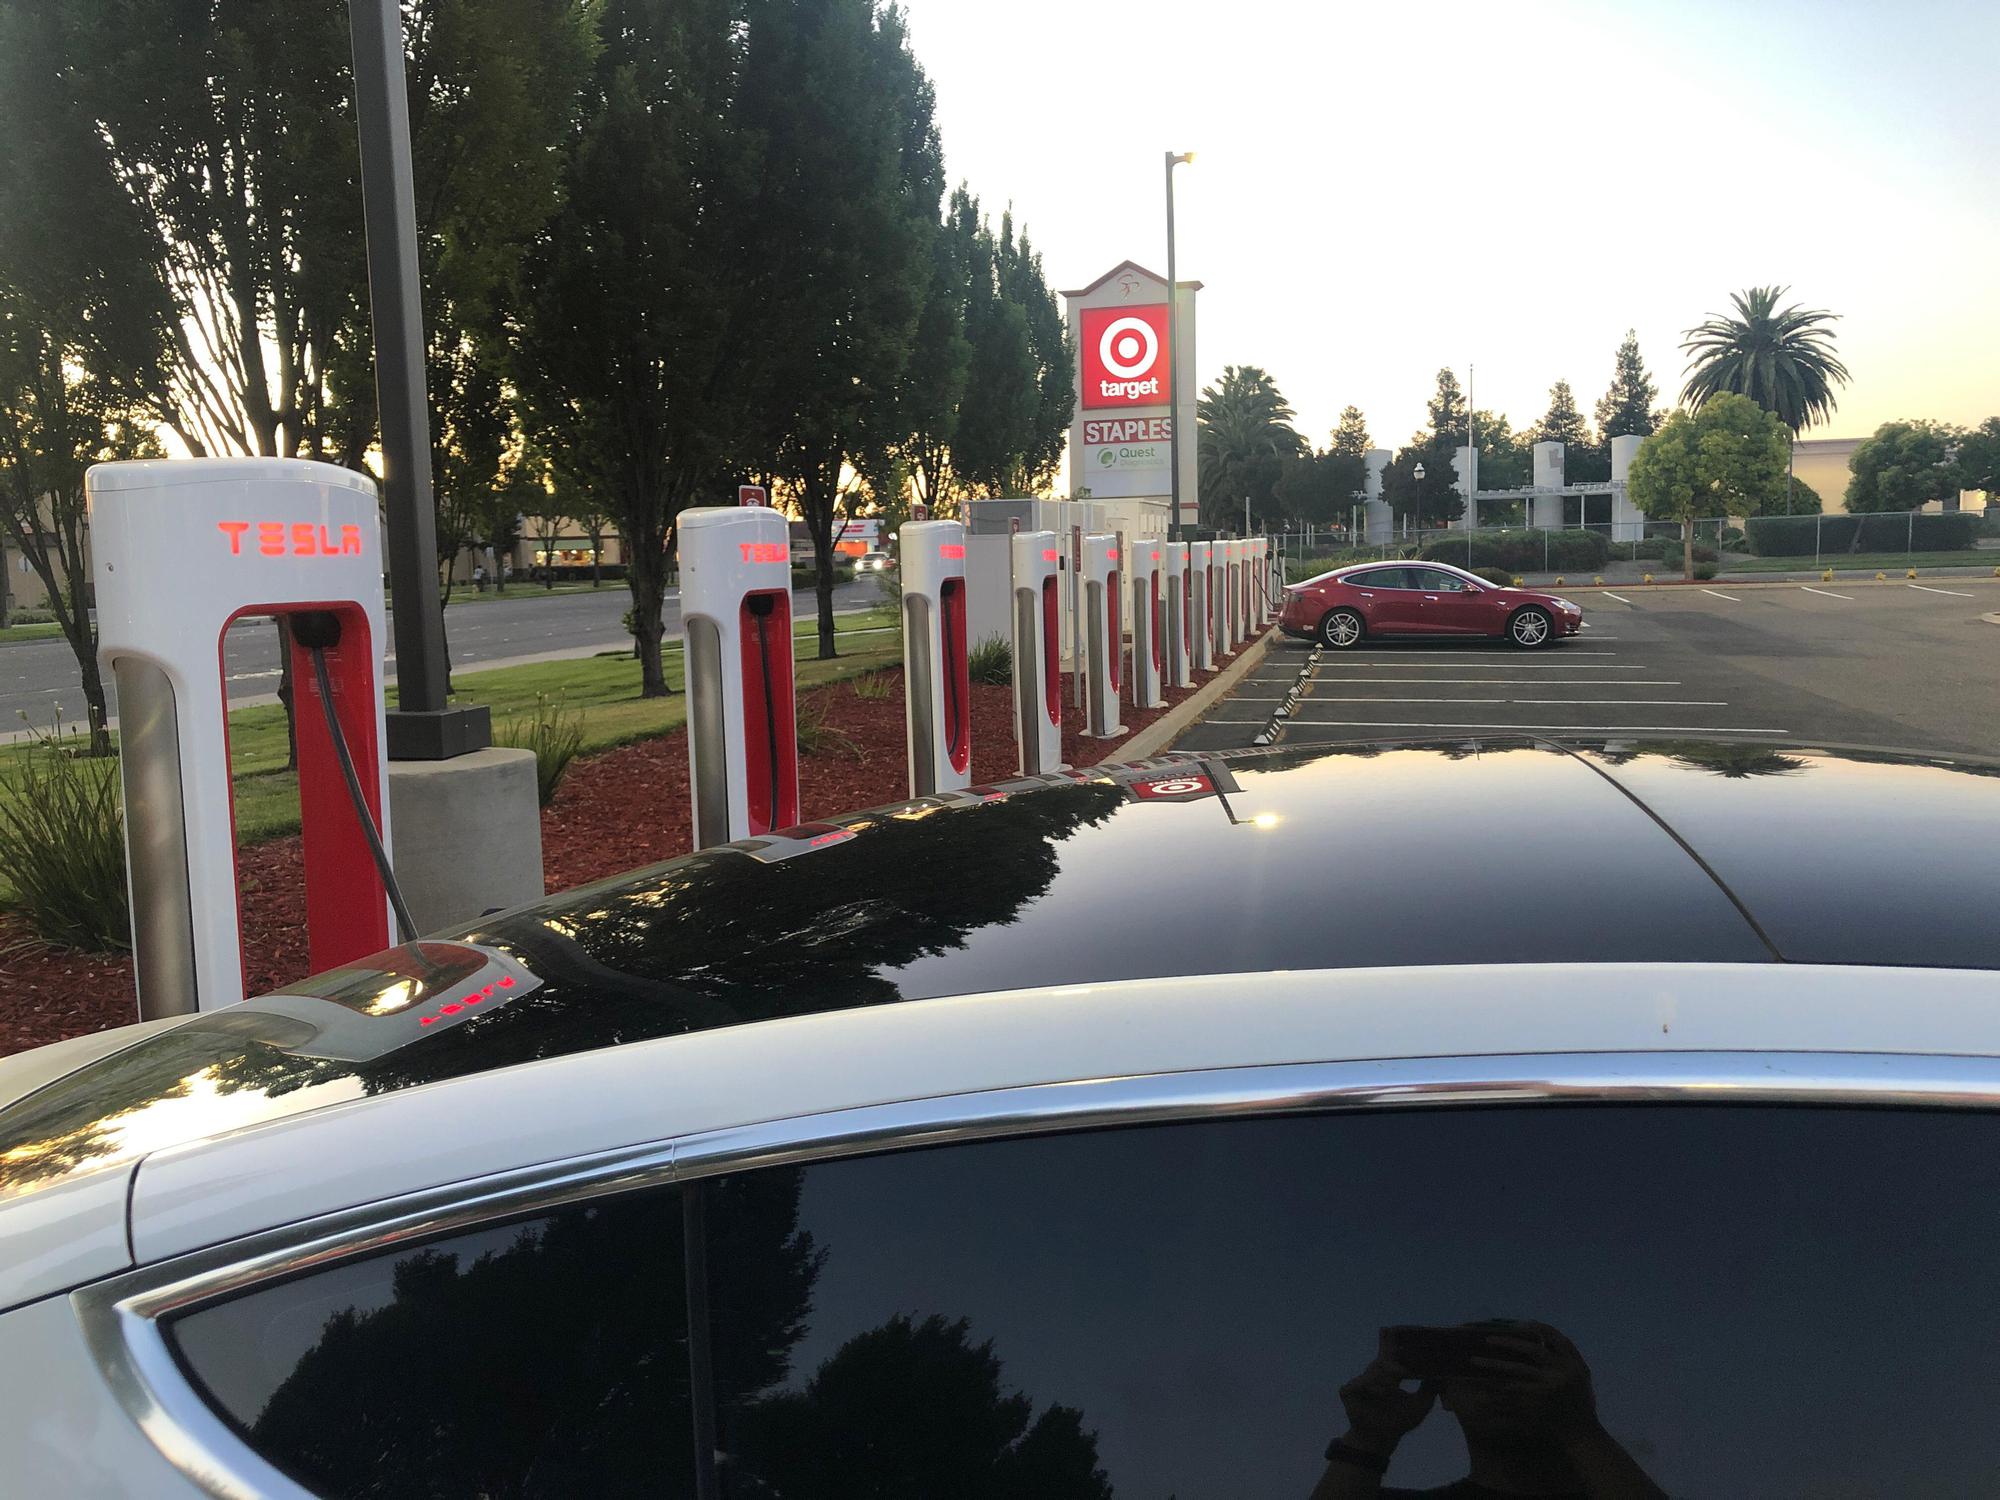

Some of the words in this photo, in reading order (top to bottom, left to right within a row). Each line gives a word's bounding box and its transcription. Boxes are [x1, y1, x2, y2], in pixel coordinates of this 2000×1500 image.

[1100, 377, 1159, 399] target
[1086, 418, 1172, 442] STAPLES
[1119, 447, 1156, 458] Quest
[217, 522, 362, 556] TESLA
